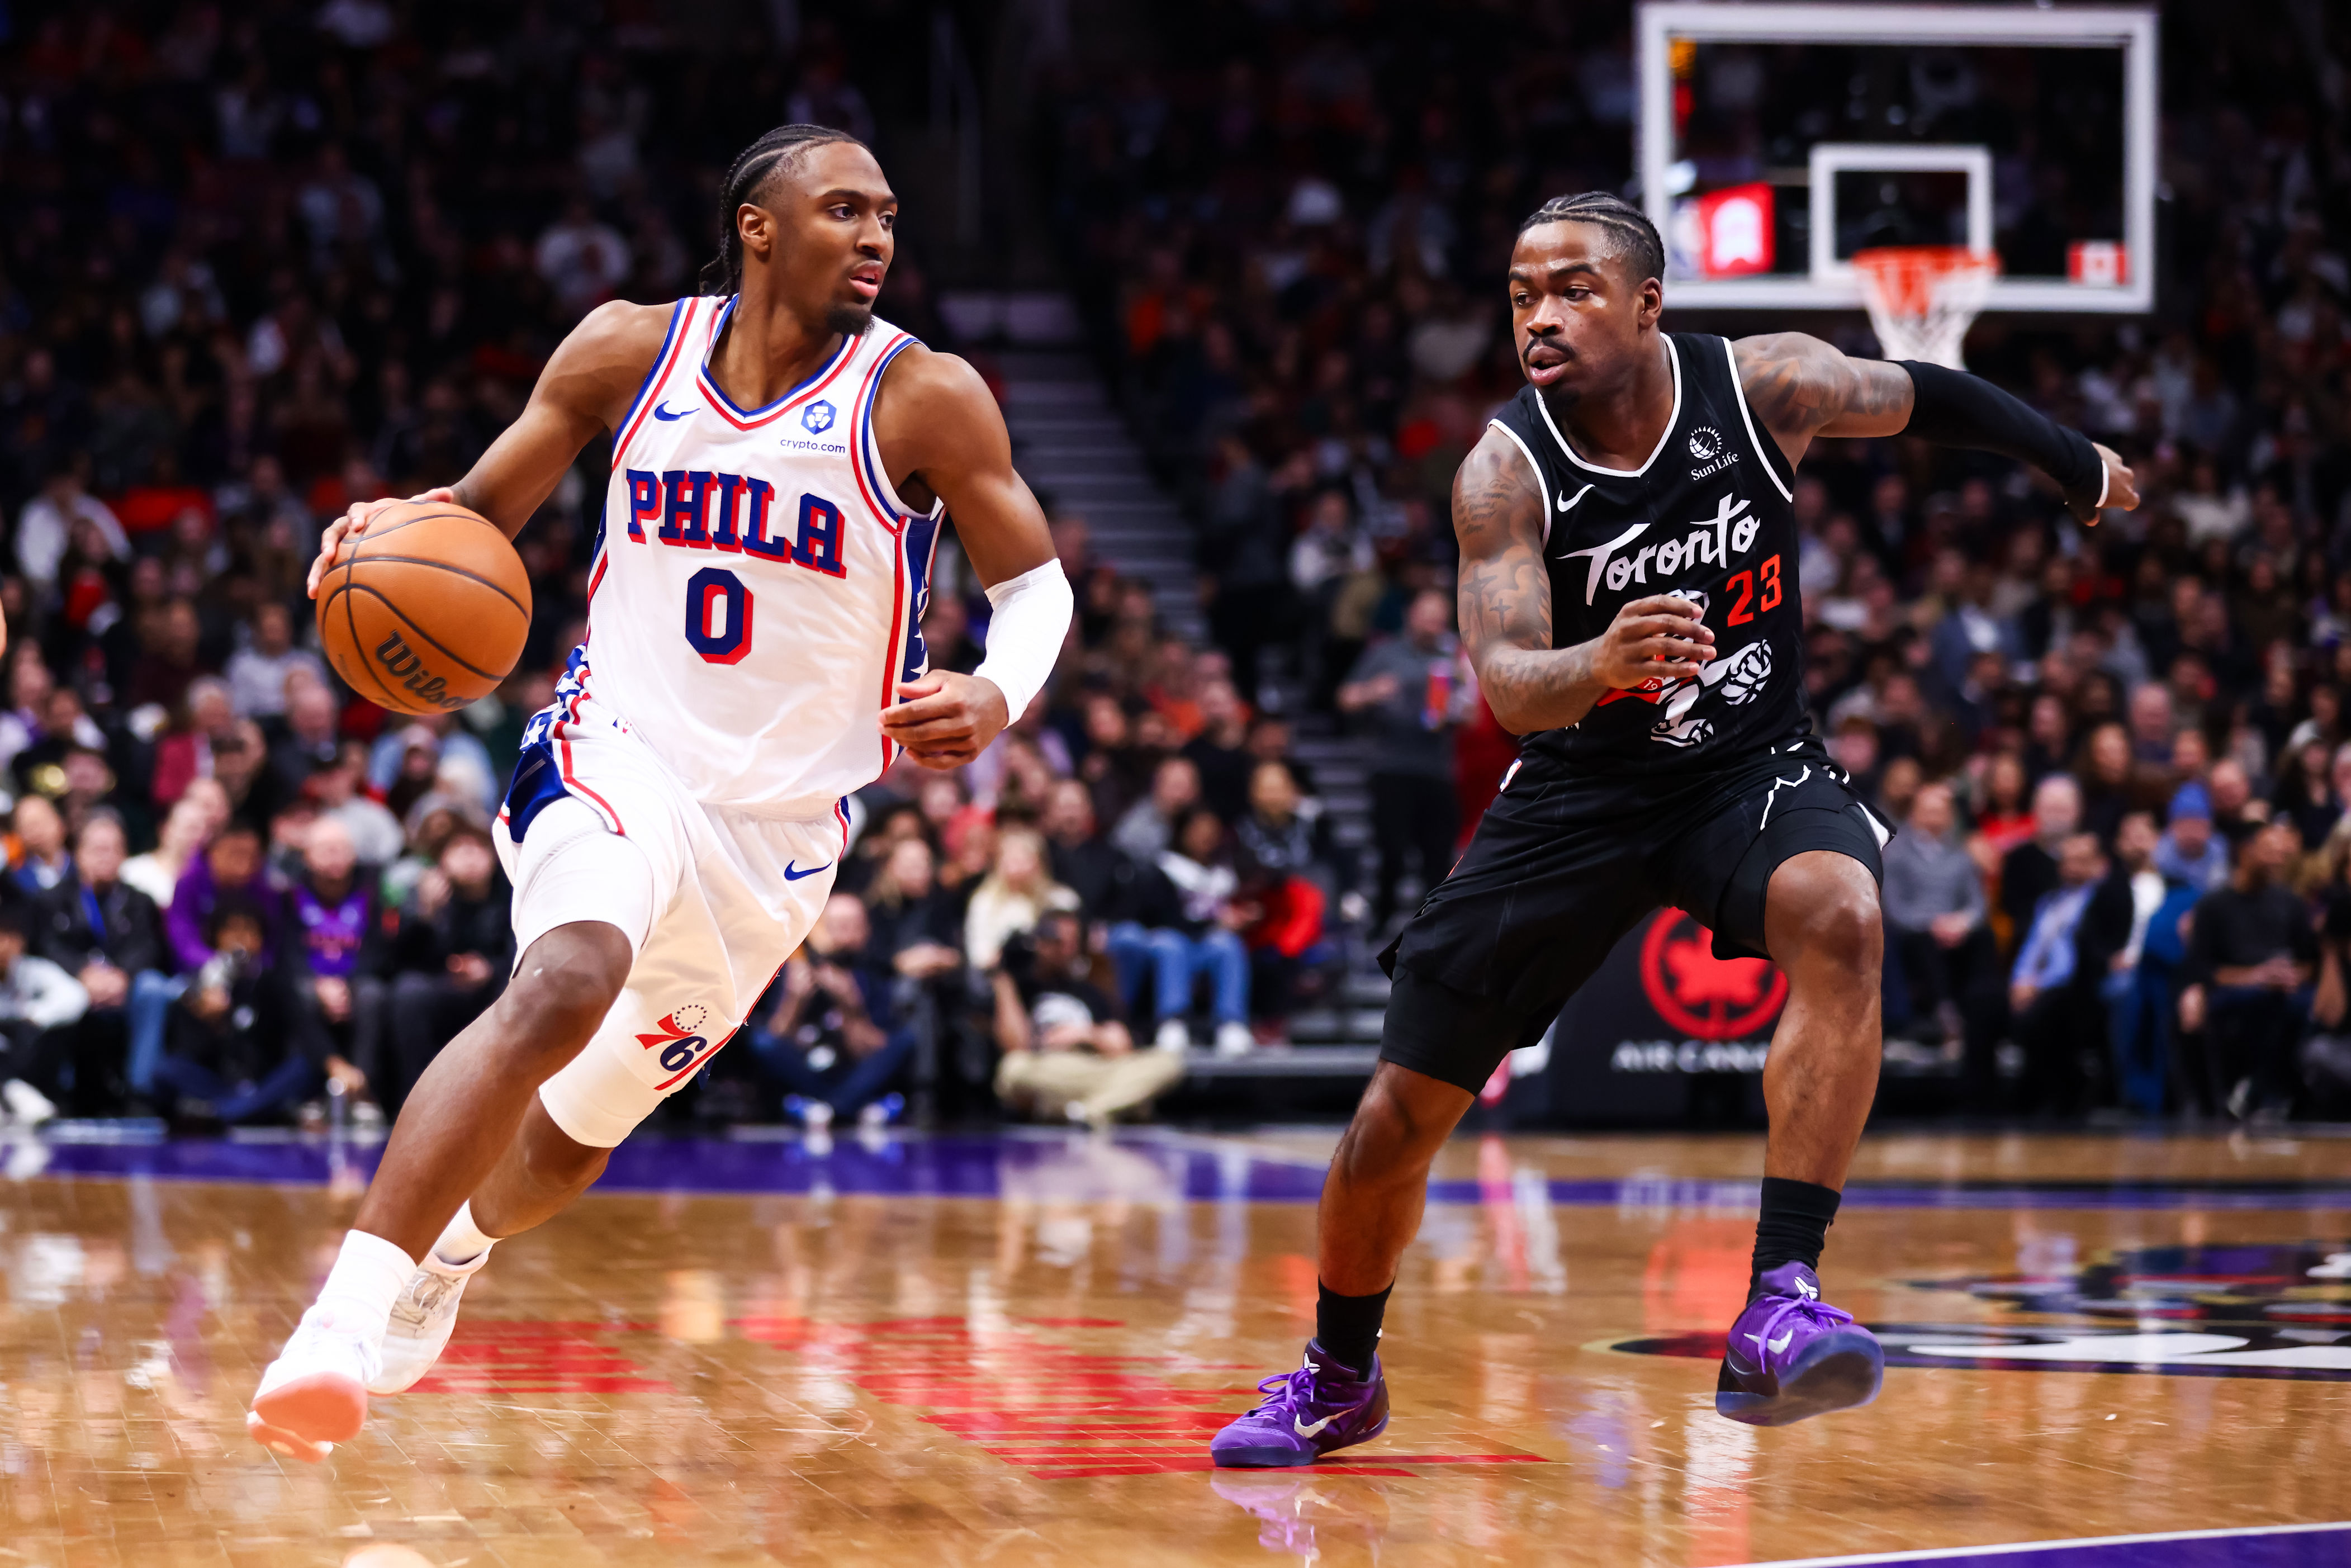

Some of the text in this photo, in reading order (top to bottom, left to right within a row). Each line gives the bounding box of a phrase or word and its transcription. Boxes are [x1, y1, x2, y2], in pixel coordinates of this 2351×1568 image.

[780, 438, 846, 454] crypto.com
[1691, 452, 1739, 481] Sun Life
[627, 468, 847, 579] PHILA
[1556, 492, 1760, 606] Toronto
[685, 567, 754, 665] 0
[1726, 554, 1783, 627] 23
